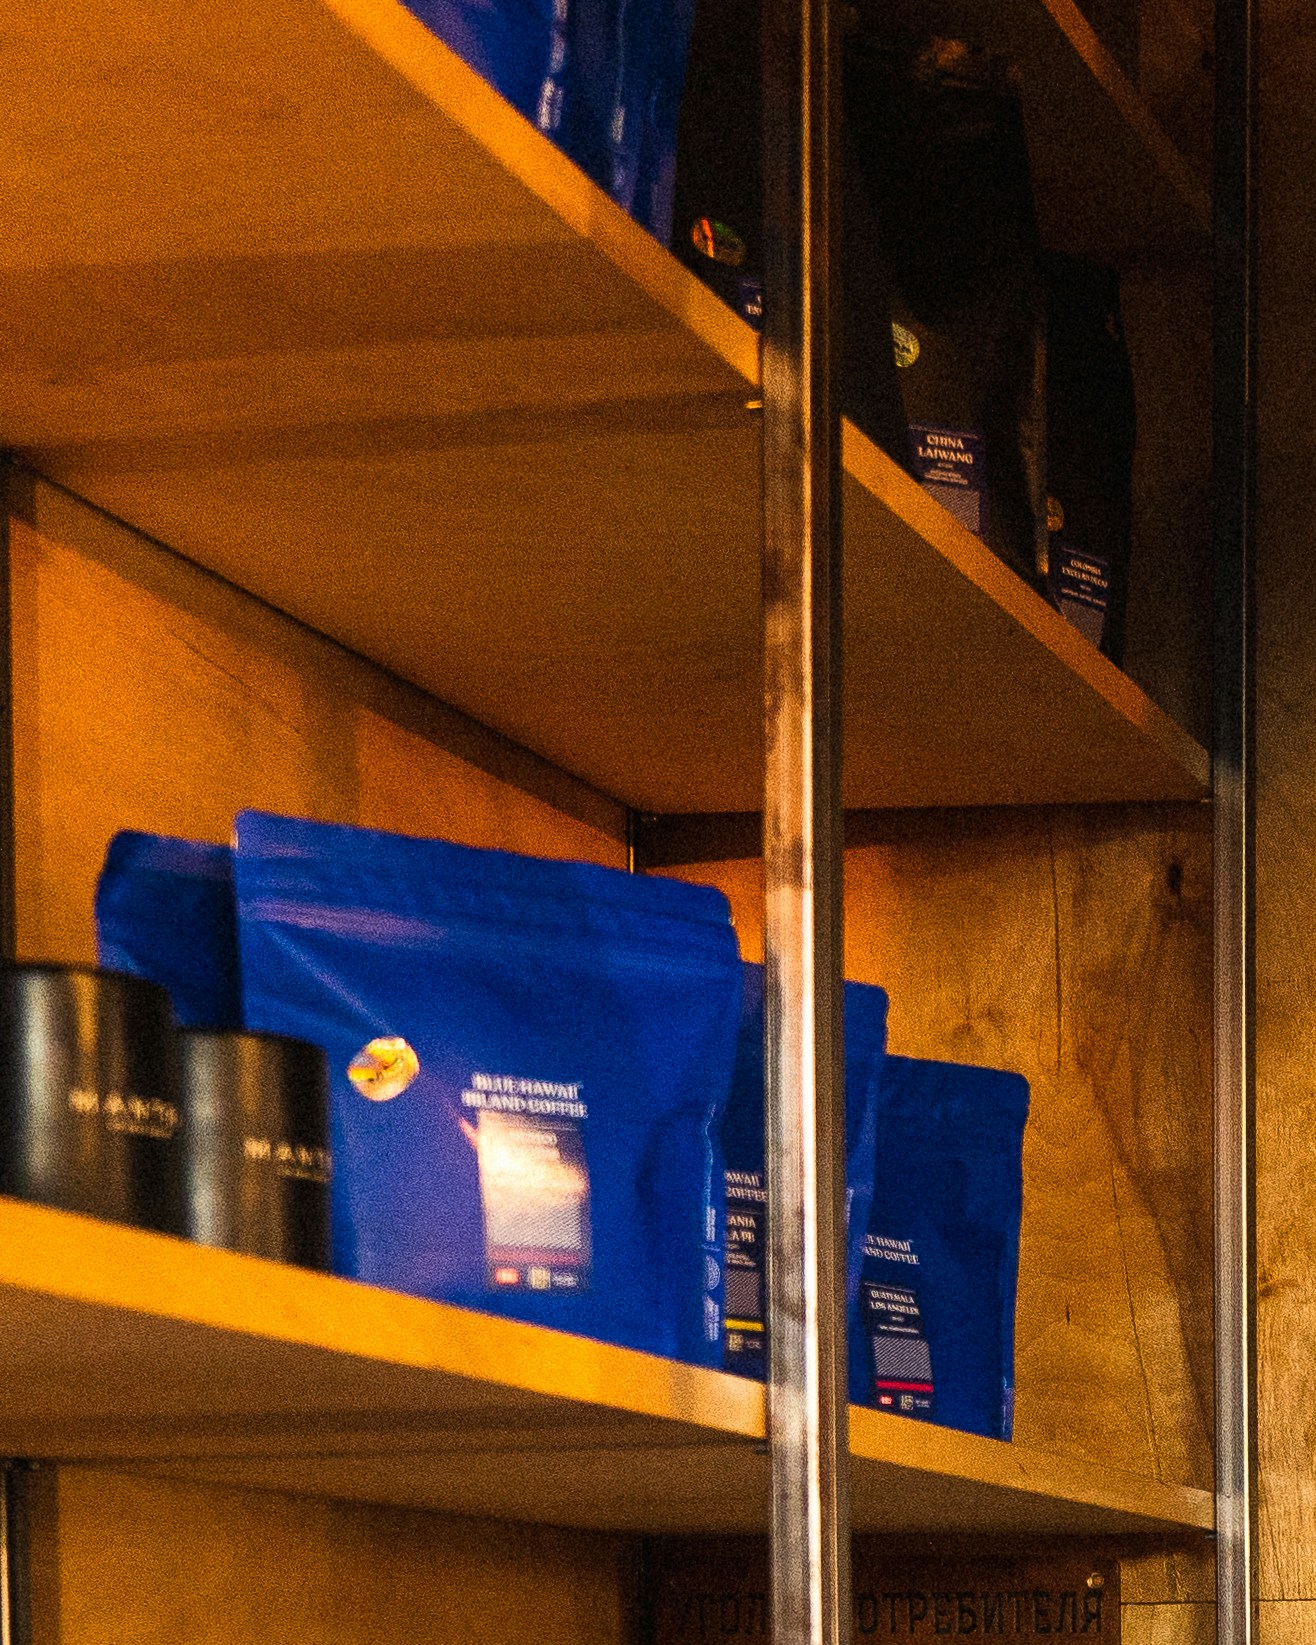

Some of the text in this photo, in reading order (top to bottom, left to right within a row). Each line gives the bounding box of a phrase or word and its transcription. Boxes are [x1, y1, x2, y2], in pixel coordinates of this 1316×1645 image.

[926, 434, 964, 450] CHINA
[917, 446, 974, 465] LAIWANG
[520, 1078, 580, 1100] HAWAII
[725, 1172, 762, 1187] AWAII
[877, 1236, 911, 1252] HAWAII
[884, 1249, 920, 1265] COFFEE
[870, 1290, 915, 1304] GUATEMALA
[677, 1589, 1103, 1635] УГОЛ ОТРЕБИТЕЛЯ
